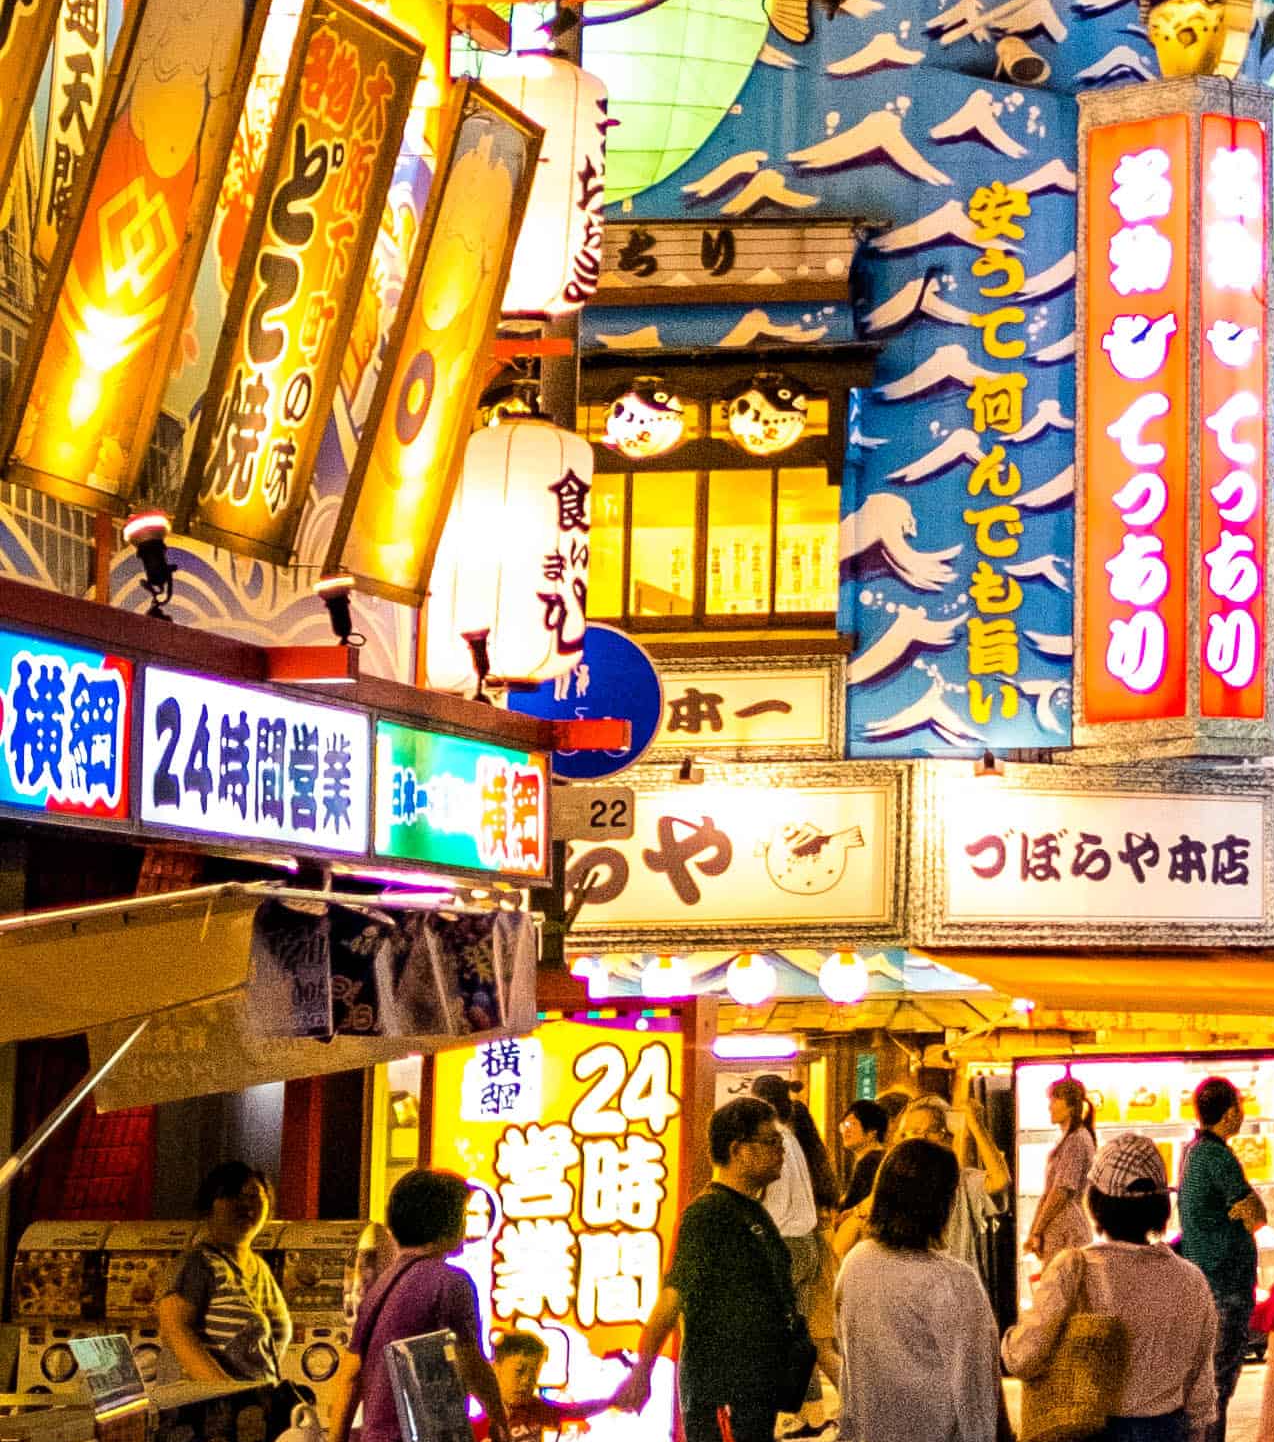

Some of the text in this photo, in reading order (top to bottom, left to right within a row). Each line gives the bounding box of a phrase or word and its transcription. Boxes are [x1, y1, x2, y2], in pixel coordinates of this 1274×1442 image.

[265, 60, 396, 516] 大阪下町の味
[963, 180, 1031, 726] 安うて何んでも旨い
[1104, 391, 1171, 697] てっちり
[1203, 391, 1262, 692] てっちり
[12, 657, 121, 804] 横綱
[152, 694, 354, 836] 24時間営業
[590, 799, 627, 828] 22
[964, 828, 1251, 886] づぼらや本店
[479, 1039, 523, 1116] 横綱
[494, 1122, 579, 1321] 営業
[571, 1042, 681, 1327] 24時間
